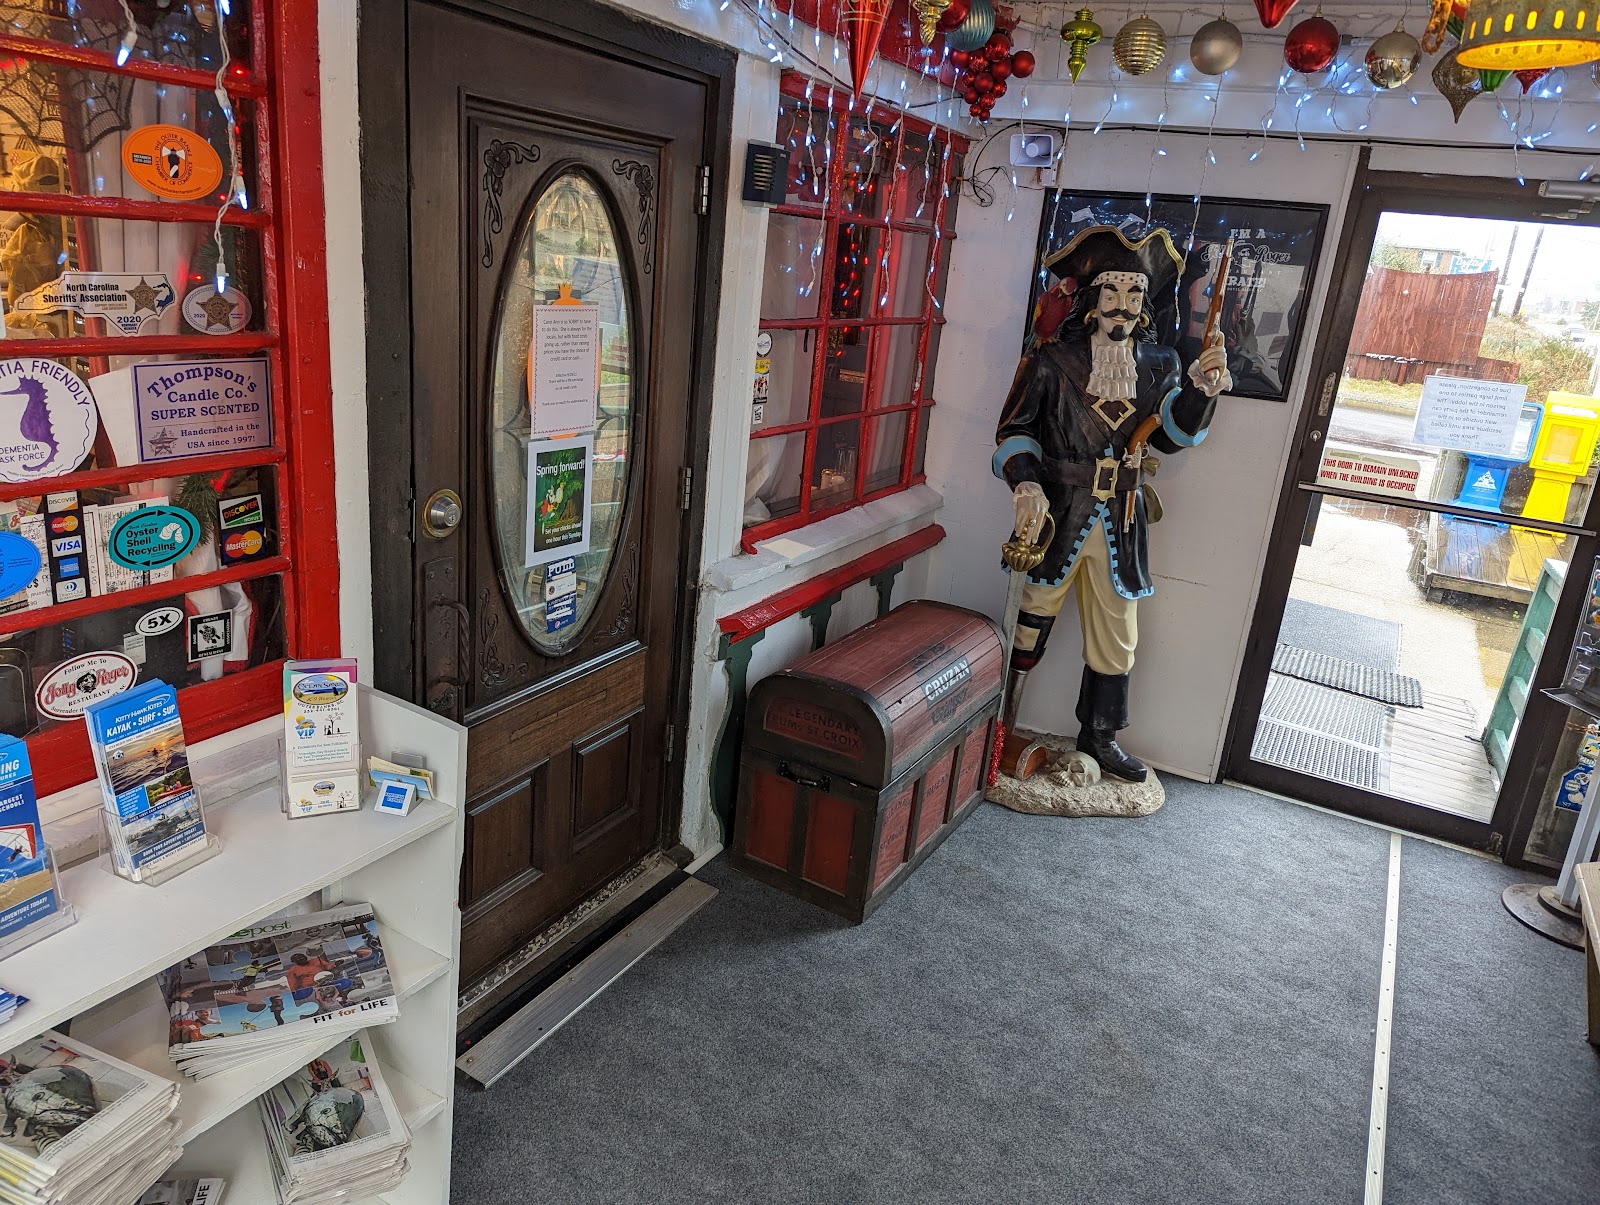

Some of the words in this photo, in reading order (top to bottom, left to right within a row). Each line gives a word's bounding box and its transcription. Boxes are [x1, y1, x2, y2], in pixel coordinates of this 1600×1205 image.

[179, 137, 192, 157] BANKS
[1229, 228, 1251, 239] I'M
[1255, 228, 1266, 239] A
[1254, 244, 1291, 265] Roger
[66, 283, 87, 292] North
[88, 283, 119, 292] Carolina
[1227, 275, 1266, 288] RATE!
[42, 293, 78, 304] Sheriffs'
[80, 293, 127, 302] Association
[116, 315, 141, 324] 2020
[31, 361, 90, 406] FRIENDLY
[147, 366, 257, 398] Thompson's
[167, 388, 220, 403] Candle
[224, 387, 248, 399] Co.
[151, 407, 196, 421] SUPER
[200, 402, 260, 416] SCENTED
[180, 425, 234, 437] Handcrafted
[235, 424, 244, 432] in
[187, 441, 205, 449] USA
[207, 438, 230, 447] since
[232, 435, 256, 444] 1997!
[18, 452, 45, 462] FORCE
[536, 463, 558, 478] Spring
[559, 458, 585, 473] forward!
[1323, 458, 1337, 467] THIS
[1337, 460, 1353, 470] DOOR
[1354, 462, 1362, 471] TO
[1362, 463, 1387, 475] REMAIN
[1387, 467, 1419, 480] UNLOCKED
[1320, 470, 1337, 480] WHEN
[1338, 472, 1349, 482] THE
[1350, 474, 1378, 486] BUILDING
[1378, 478, 1386, 487] IS
[1386, 480, 1416, 492] OCCUPIED
[49, 496, 76, 505] DISCOVER
[223, 501, 258, 518] DISCOVER
[126, 527, 158, 538] Oyster
[54, 539, 81, 552] VISA
[126, 536, 151, 548] Shell
[127, 541, 176, 557] Recycling
[226, 538, 262, 551] MasterCard
[147, 612, 172, 629] 5X
[64, 663, 85, 675] Follow
[87, 659, 97, 667] Me
[44, 681, 77, 706] Jolly
[95, 665, 129, 687] Roger
[924, 659, 970, 701] CRUZAN
[68, 689, 111, 707] RESTAURANT
[115, 713, 131, 723] KITTY
[131, 707, 148, 717] HAWK
[147, 700, 163, 711] KITES
[106, 721, 132, 738] KAYAK
[138, 711, 156, 726] SURF
[162, 704, 176, 717] SUP
[790, 707, 860, 735] LEGENDARY
[297, 729, 315, 737] VIP
[823, 730, 860, 749] CROIX
[1, 904, 30, 923] ADVENTURE
[30, 896, 48, 909] TODAY!
[313, 1012, 333, 1024] FIT
[338, 1008, 356, 1017] for
[360, 999, 388, 1012] LIFE
